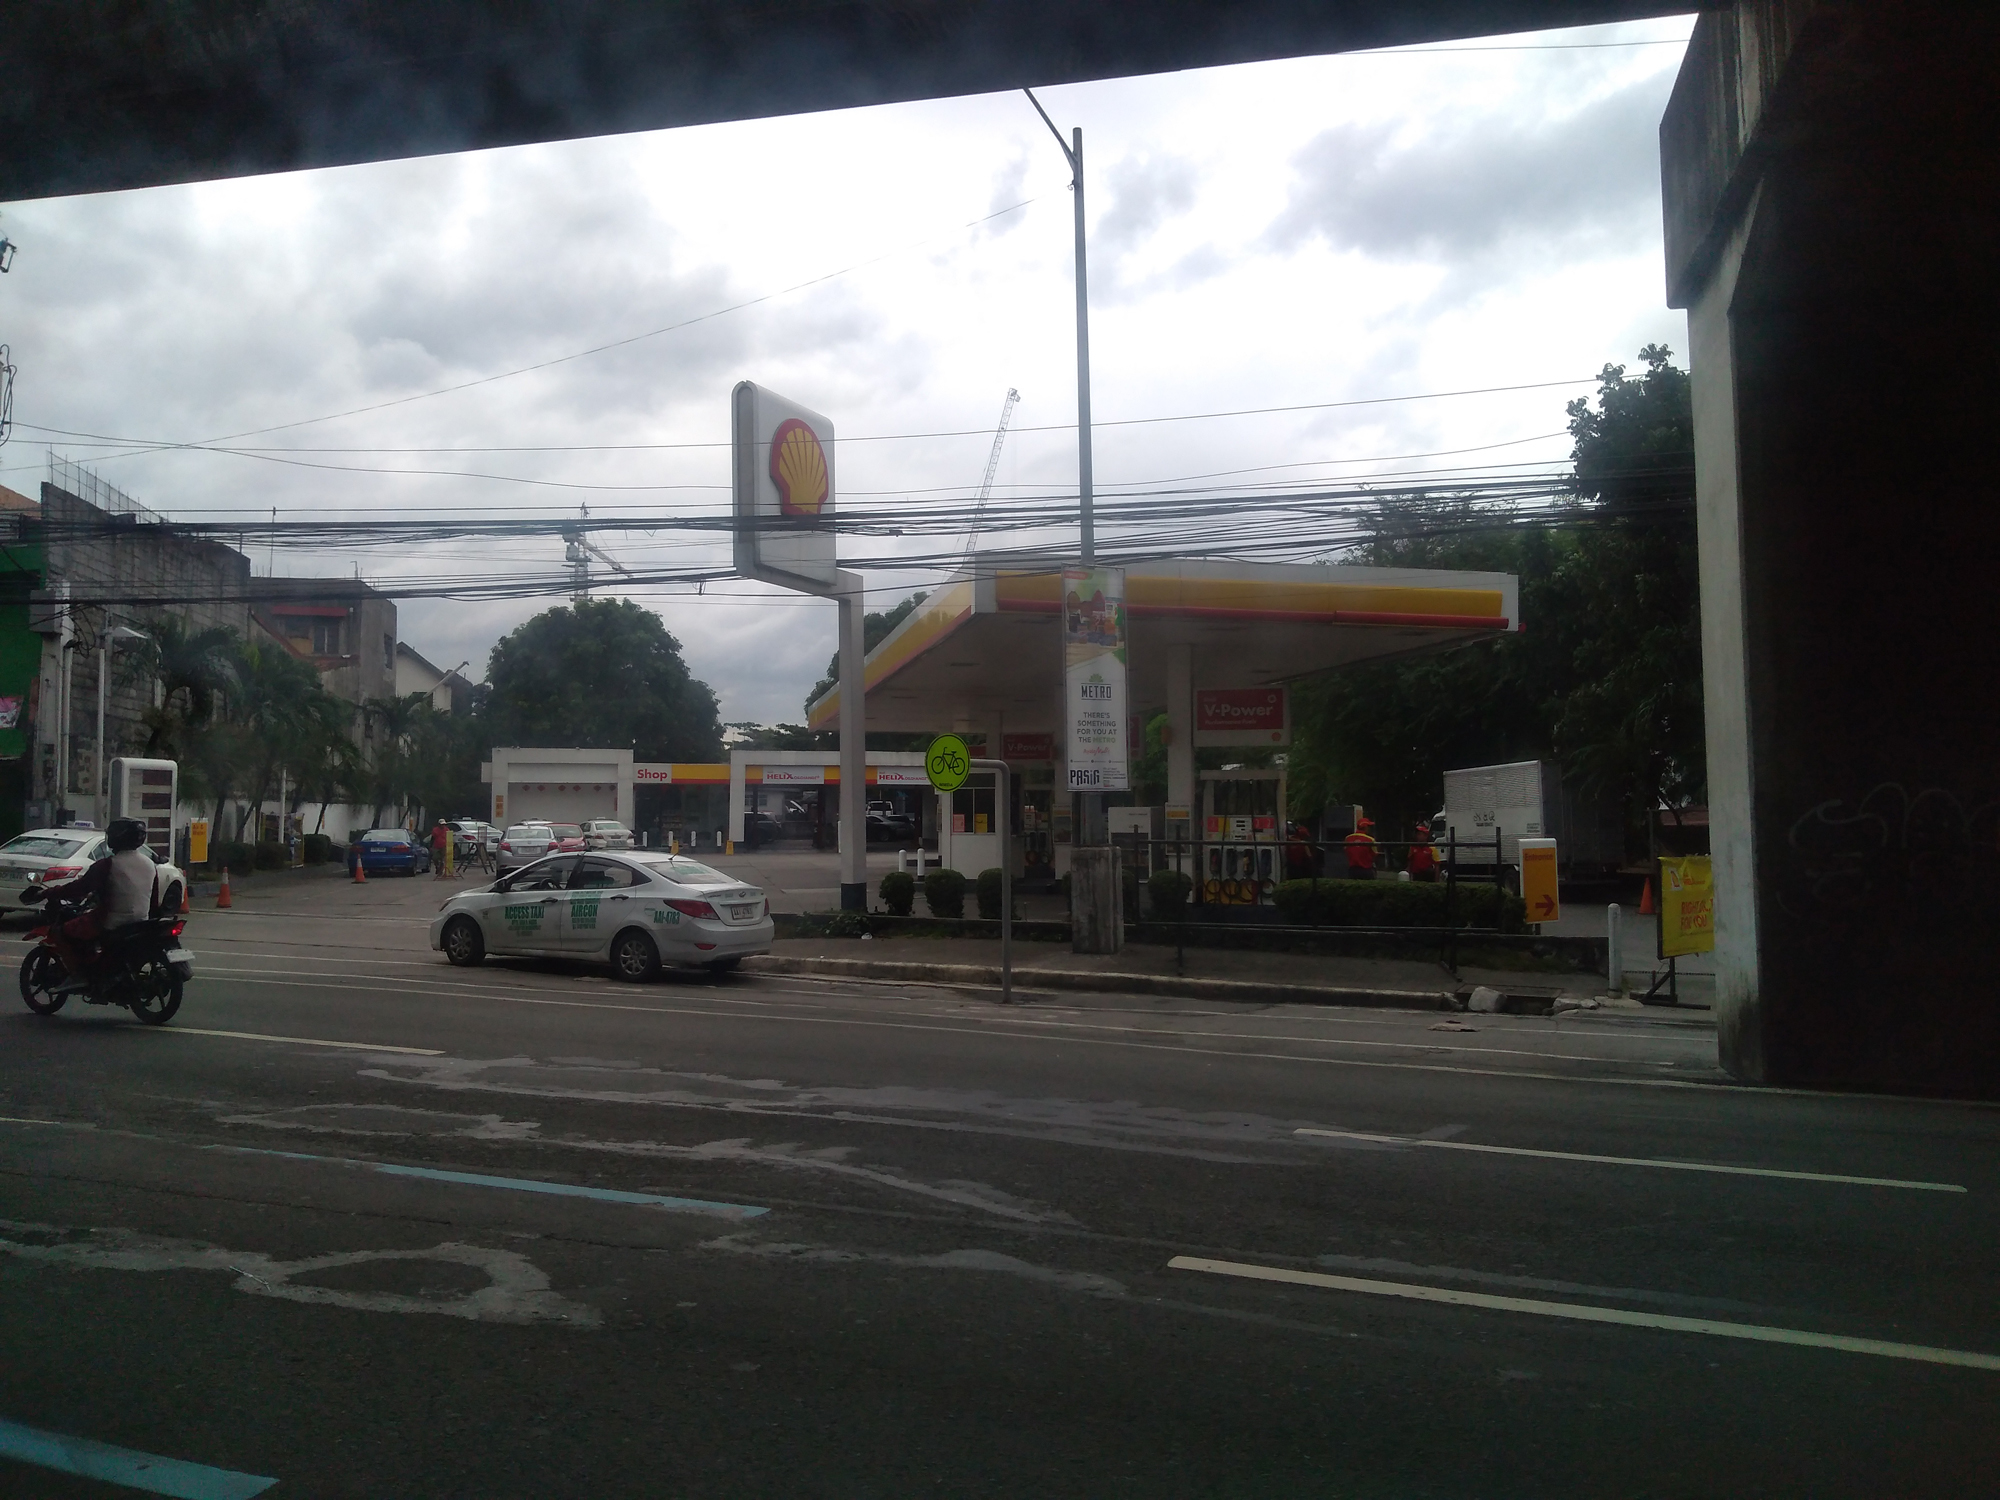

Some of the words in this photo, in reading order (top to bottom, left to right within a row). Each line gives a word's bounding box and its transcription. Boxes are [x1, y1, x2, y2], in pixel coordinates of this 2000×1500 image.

[1081, 685, 1112, 699] METRO
[1083, 711, 1111, 719] THERE'S
[1203, 703, 1273, 717] V-Power
[1007, 743, 1048, 752] V-Power
[637, 768, 668, 782] Shop
[766, 772, 794, 780] HELIX
[879, 773, 904, 781] HELIX
[504, 906, 530, 919] ACCESS
[530, 905, 545, 919] TAXI
[571, 904, 599, 918] AIRCON
